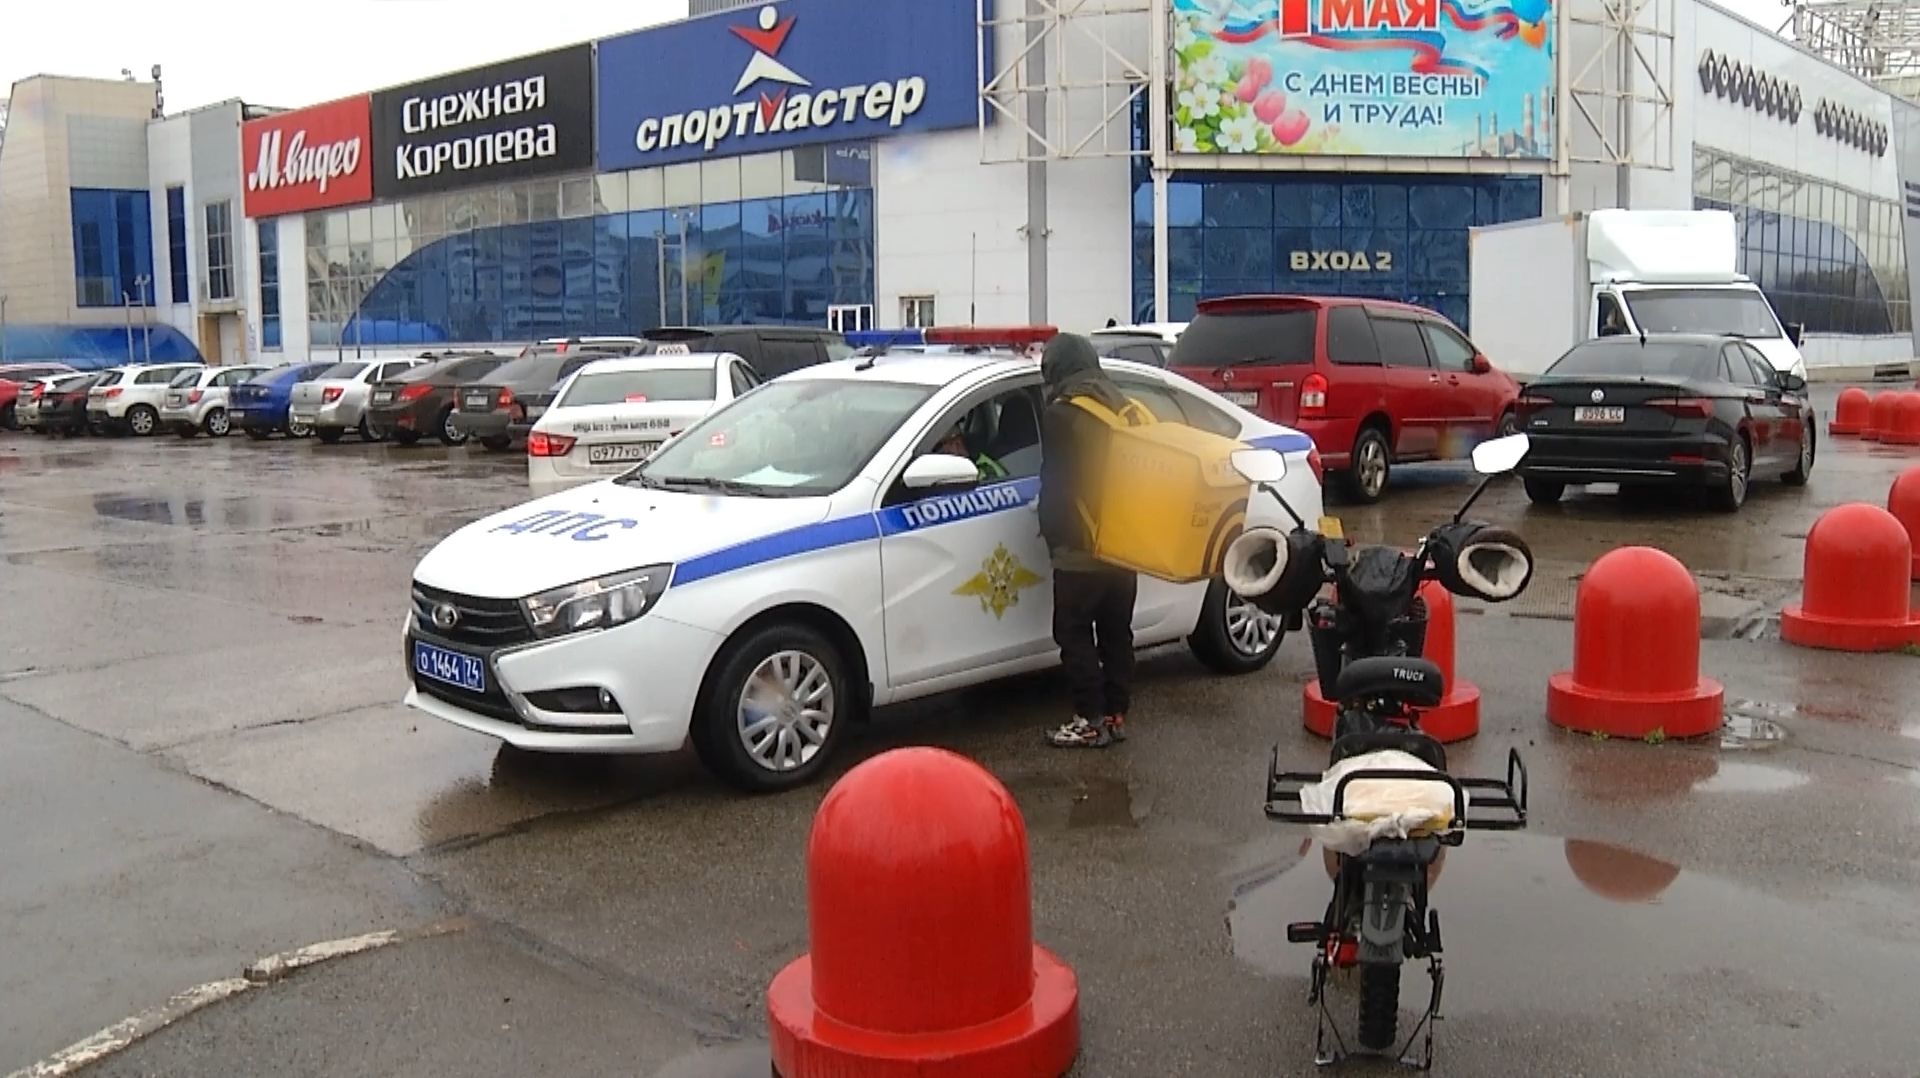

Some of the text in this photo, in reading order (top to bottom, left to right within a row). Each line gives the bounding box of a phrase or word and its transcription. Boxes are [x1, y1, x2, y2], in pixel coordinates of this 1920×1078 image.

[1320, 0, 1438, 30] МАЯ
[1285, 73, 1480, 97] С ДНЕМ ВЕСНЫ
[403, 75, 546, 134] Снежная
[1324, 104, 1443, 127] И ТРУДА!
[248, 129, 361, 193] М.видео
[396, 123, 557, 179] Королева
[1290, 251, 1392, 271] ВХОД 2
[902, 486, 1021, 526] ПОЛИЦИЯ
[487, 510, 638, 541] ДПС
[465, 659, 479, 681] 74
[1393, 667, 1425, 681] TRUCK
